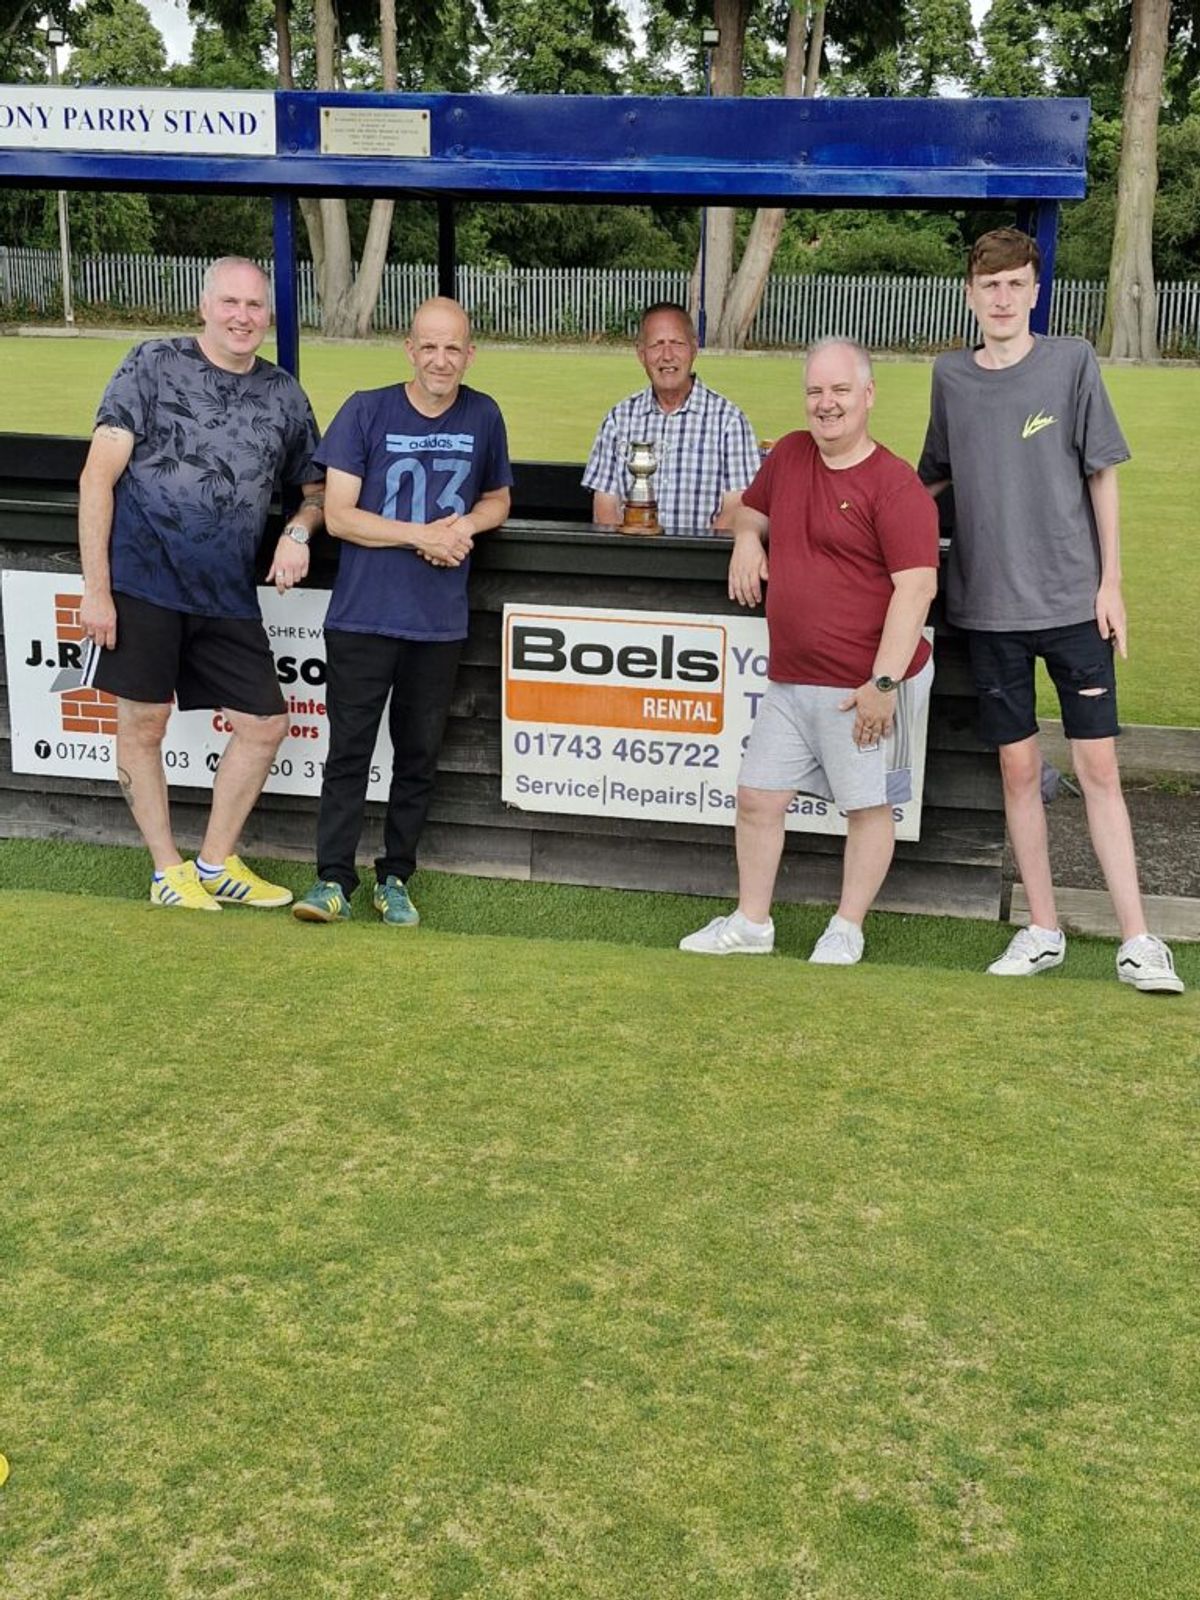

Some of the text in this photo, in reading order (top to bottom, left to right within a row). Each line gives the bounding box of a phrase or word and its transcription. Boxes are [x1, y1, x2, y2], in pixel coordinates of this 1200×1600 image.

[64, 106, 154, 133] PARRY
[164, 109, 257, 136] STAND
[409, 436, 453, 450] adidas
[382, 457, 472, 525] 03
[268, 625, 322, 639] SHREW
[25, 640, 83, 669] J.R
[512, 625, 719, 682] Boels
[731, 647, 769, 676] Yo
[643, 697, 717, 722] RENTAL
[56, 742, 110, 762] 01743
[514, 731, 602, 760] 01743
[612, 737, 719, 768] 465722
[516, 775, 600, 798] Service
[610, 782, 697, 807] Repairs
[785, 797, 828, 816] Gas
